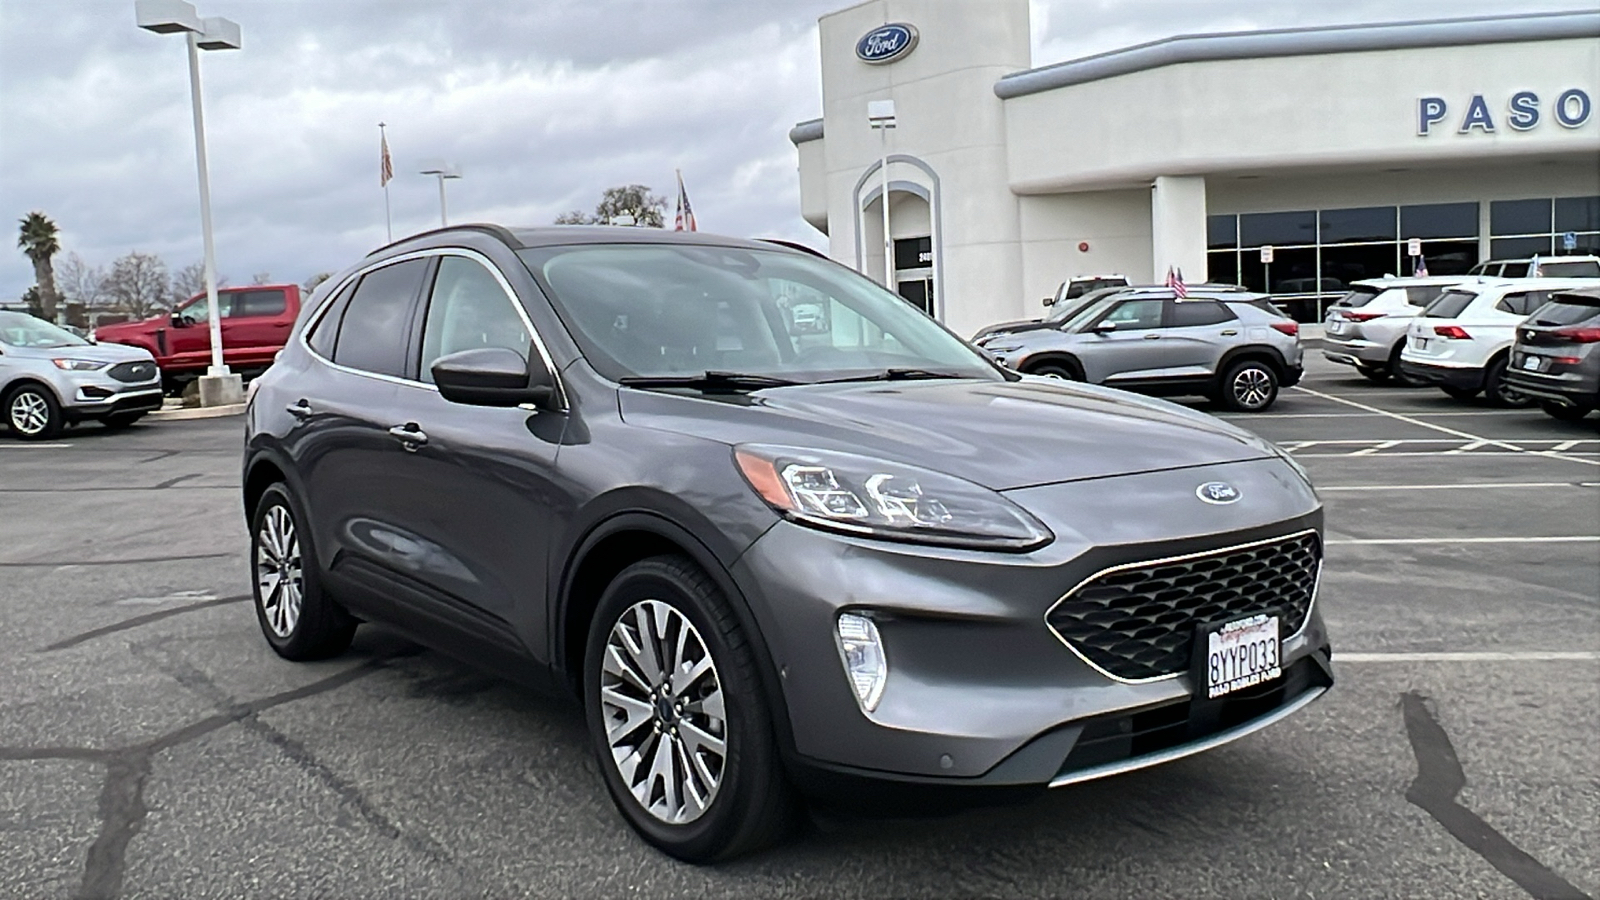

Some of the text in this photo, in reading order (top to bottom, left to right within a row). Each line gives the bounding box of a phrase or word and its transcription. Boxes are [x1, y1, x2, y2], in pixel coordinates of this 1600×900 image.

[864, 30, 900, 57] Ford
[1416, 87, 1592, 136] PASO
[1208, 484, 1237, 499] Ford
[1210, 637, 1277, 685] 8YYP033
